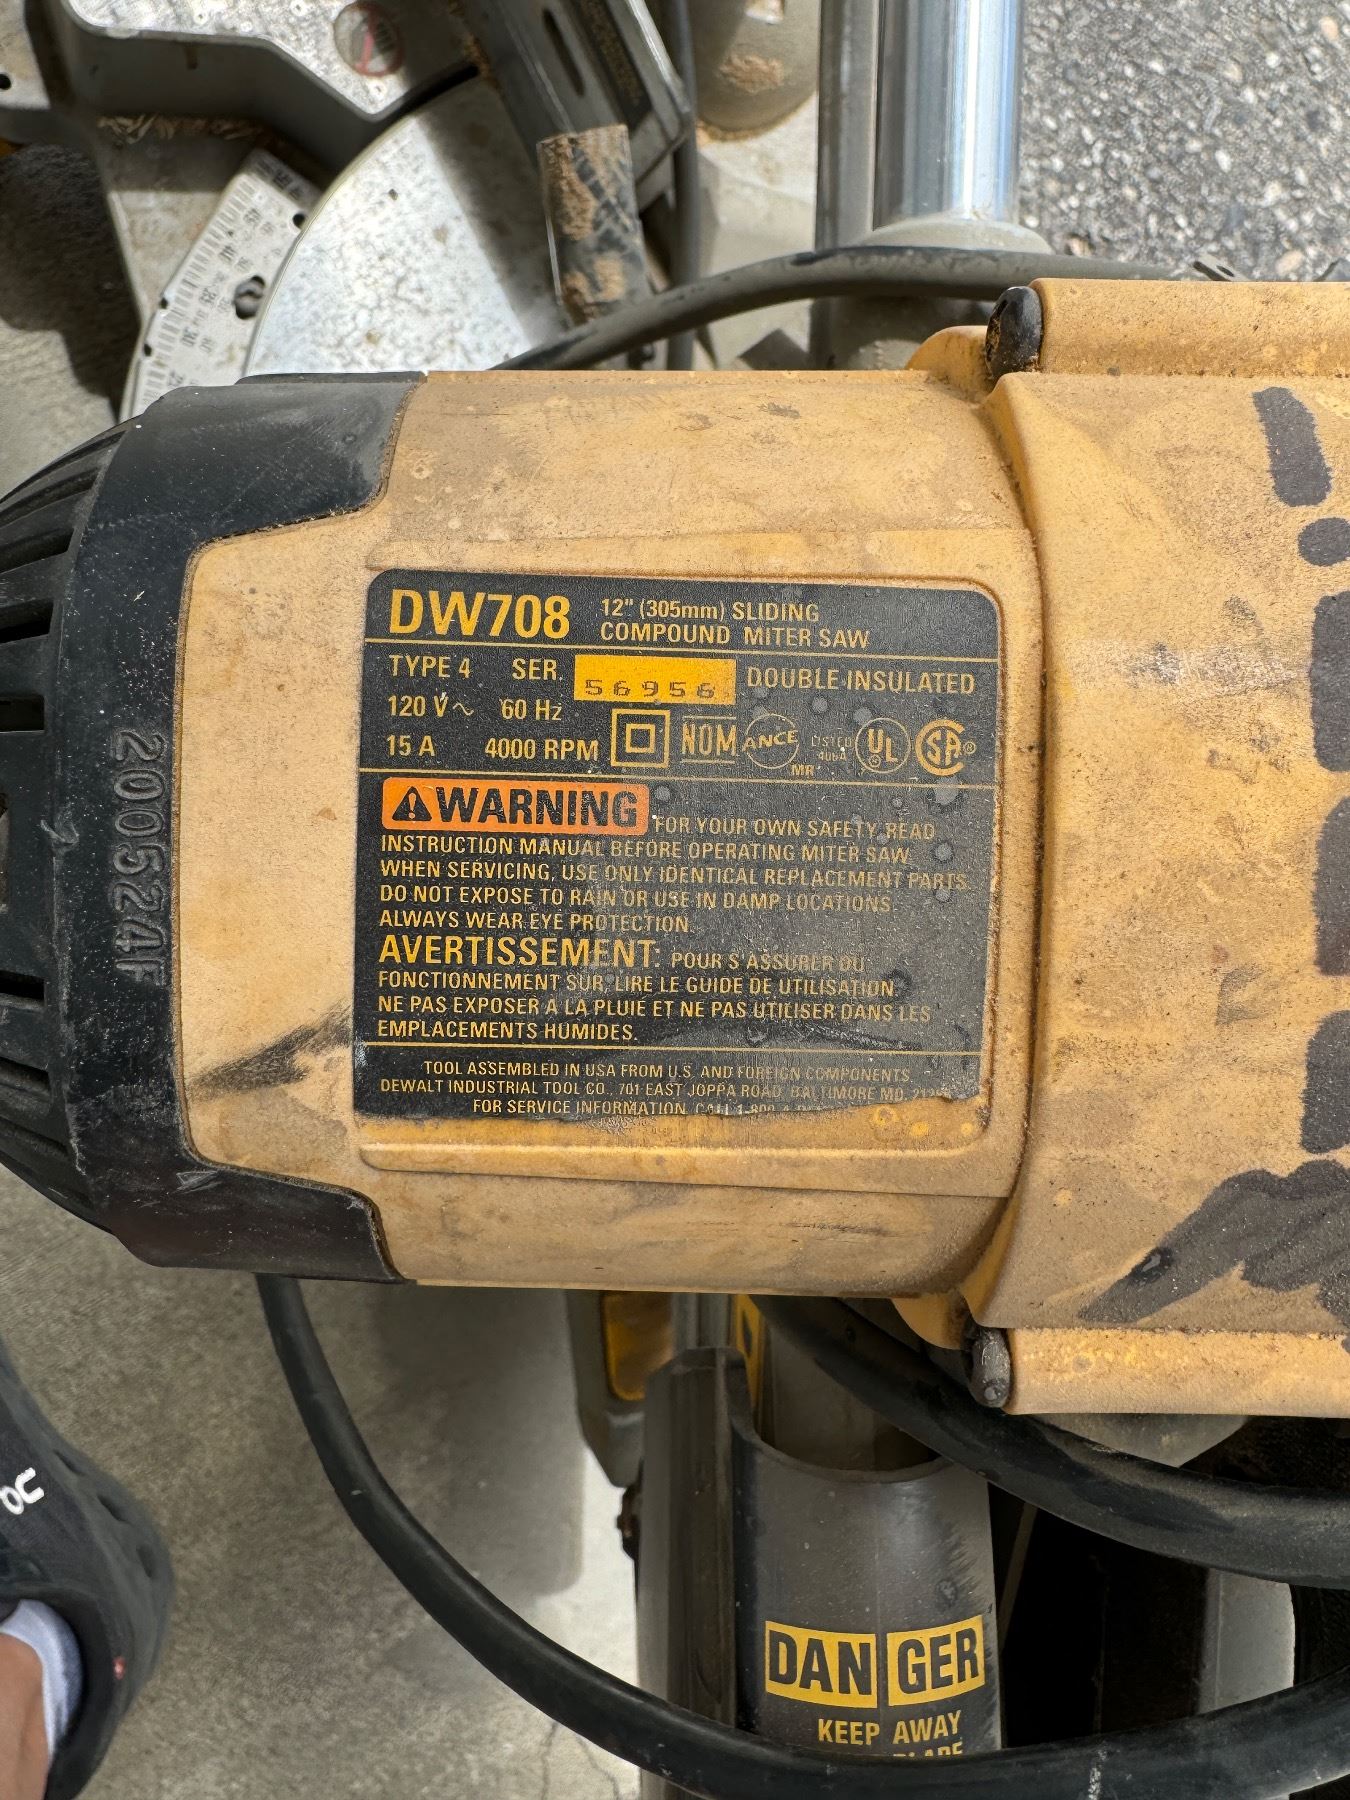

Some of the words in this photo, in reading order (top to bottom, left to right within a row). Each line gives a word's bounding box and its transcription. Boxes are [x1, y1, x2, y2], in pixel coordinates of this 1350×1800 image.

[389, 588, 571, 640] DW708
[601, 598, 634, 618] 12"
[639, 598, 726, 621] (305mm)
[732, 601, 820, 622] SLIDING
[600, 621, 731, 645] COMPOUND
[744, 627, 812, 647] MITER
[818, 629, 871, 649] SAW
[389, 654, 451, 679] TYPE
[458, 656, 471, 679] 4
[584, 678, 716, 699] 56956
[746, 666, 839, 690] DOUBLE
[845, 669, 976, 696] INSULATED
[388, 695, 426, 717] 120
[500, 698, 527, 720] 60
[535, 700, 563, 722] Hz
[386, 734, 411, 757] 15
[417, 735, 436, 757] A
[484, 737, 536, 760] 4000
[543, 739, 600, 762] RPM
[681, 721, 738, 757] NOM
[435, 785, 640, 829] WARNING
[654, 816, 691, 834] FOR
[695, 817, 748, 836] YOUR
[753, 818, 801, 837] OWN
[807, 820, 877, 839] SAFETY
[885, 822, 936, 841] READ
[380, 833, 514, 855] INSTRUCTION
[518, 837, 602, 857] MANUAL
[611, 840, 682, 859] BEFORE
[687, 841, 797, 861] OPERATING
[801, 844, 861, 863] MITER
[866, 846, 911, 865] SAW
[380, 858, 441, 878] WHEN
[561, 864, 598, 881] USE
[604, 865, 653, 883] ONLY
[660, 866, 758, 886] IDENTICAL
[763, 868, 900, 889] REPLACEMENT
[380, 884, 407, 902] DO
[413, 885, 454, 903] NOT
[459, 886, 534, 906] EXPOSE
[539, 888, 563, 906] TO
[570, 888, 617, 907] RAIN
[623, 890, 650, 908] OR
[654, 891, 690, 909] USE
[696, 892, 716, 909] IN
[722, 892, 780, 911] DAMP
[379, 909, 460, 928] ALWAYS
[465, 910, 524, 930] WEAR
[530, 912, 564, 931] EYE
[670, 951, 723, 970] POUR
[378, 970, 560, 991] FONCTIONNEMENT
[615, 975, 653, 993] LIRE
[659, 976, 680, 993] LE
[686, 975, 743, 995] GUIDE
[750, 977, 772, 996] DE
[378, 995, 404, 1013] NE
[410, 995, 448, 1013] PAS
[453, 996, 540, 1016] EXPOSER
[565, 998, 588, 1016] LA
[593, 998, 646, 1018] PLUIE
[652, 1000, 675, 1018] ET
[680, 1000, 705, 1018] NE
[710, 1001, 747, 1019] PAS
[753, 1002, 835, 1021] UTILISER
[840, 1003, 893, 1022] DANS
[900, 1004, 932, 1023] LES
[377, 1019, 538, 1039] EMPLACEMENTS
[544, 1022, 638, 1041] HUMIDES.
[424, 1060, 463, 1076] TOOL
[467, 1060, 559, 1076] ASSEMBLED
[564, 1063, 581, 1077] IN
[585, 1063, 616, 1077] USA
[621, 1064, 664, 1078] FROM
[700, 1065, 733, 1079] AND
[737, 1065, 801, 1080] FOREIGN
[805, 1066, 911, 1082] COMPONENTS
[380, 1078, 444, 1094] DEWALT
[448, 1078, 538, 1095] INDUSTRIAL
[543, 1081, 580, 1095] TOOL
[618, 1082, 641, 1096] 701
[645, 1082, 683, 1097] EAST
[687, 1084, 736, 1098] JOPPA
[741, 1083, 782, 1099] ROAD
[790, 1085, 878, 1100] BALTIMORE
[472, 1097, 502, 1114] FOR
[506, 1098, 571, 1114] SERVICE
[768, 1627, 980, 1697] DANGER
[817, 1717, 881, 1746] KEEP
[892, 1709, 962, 1745] AWAY
